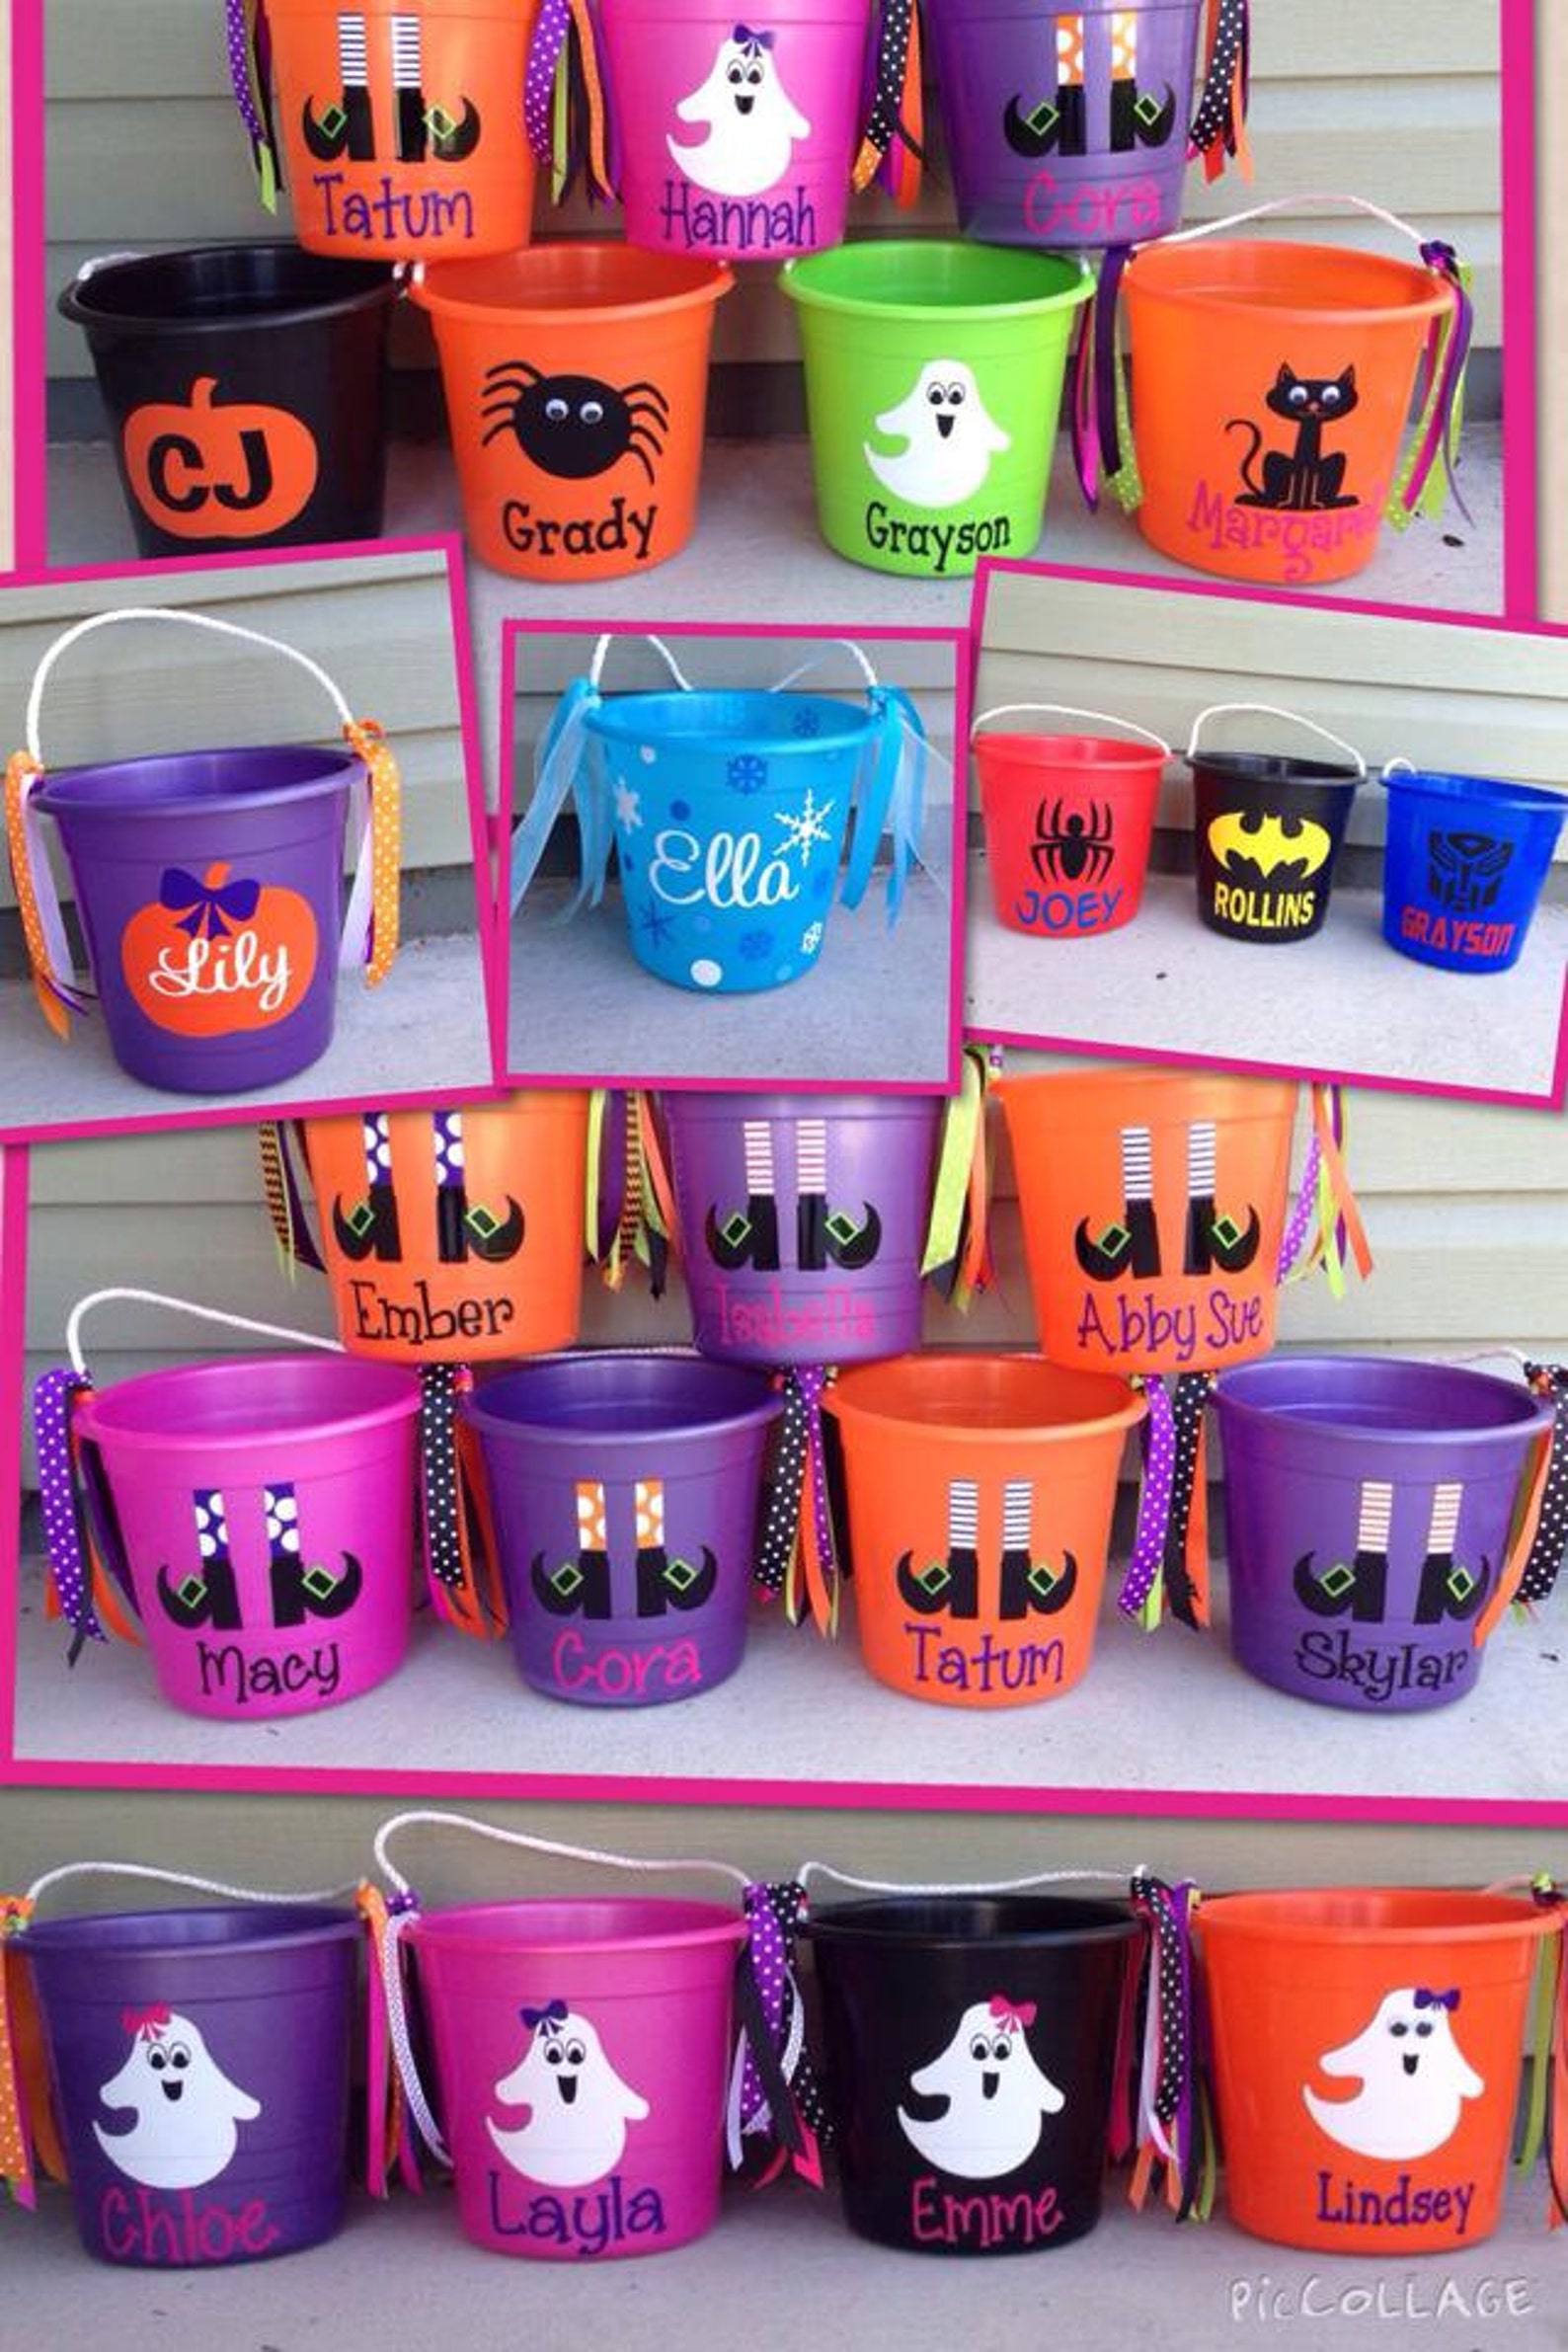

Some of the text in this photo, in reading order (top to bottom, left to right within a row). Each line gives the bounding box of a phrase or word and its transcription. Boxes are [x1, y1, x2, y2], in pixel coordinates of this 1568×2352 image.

[313, 172, 474, 240] Tatum
[660, 181, 818, 249] Hannah
[1023, 171, 1162, 235] Cora
[148, 430, 274, 512] CJ
[502, 498, 658, 559] Grady
[866, 502, 1011, 572] Grayson
[650, 828, 802, 910] Ella
[1014, 887, 1123, 930] JOEY
[1215, 881, 1314, 928] ROLLINS
[1400, 905, 1515, 957] GRAYSON
[148, 930, 290, 1012] Lily
[350, 1281, 515, 1344] Ember
[714, 1278, 876, 1346] Isabella
[1077, 1291, 1264, 1360] Abby Sue
[196, 1641, 341, 1704] Macy
[551, 1628, 704, 1695] Cora
[904, 1622, 1065, 1692] Tatum
[1294, 1630, 1470, 1702] Skylar
[100, 2185, 282, 2262] Chloe
[490, 2171, 667, 2255] Layla
[910, 2177, 1065, 2247] Emme
[1316, 2171, 1475, 2234] Lindsey
